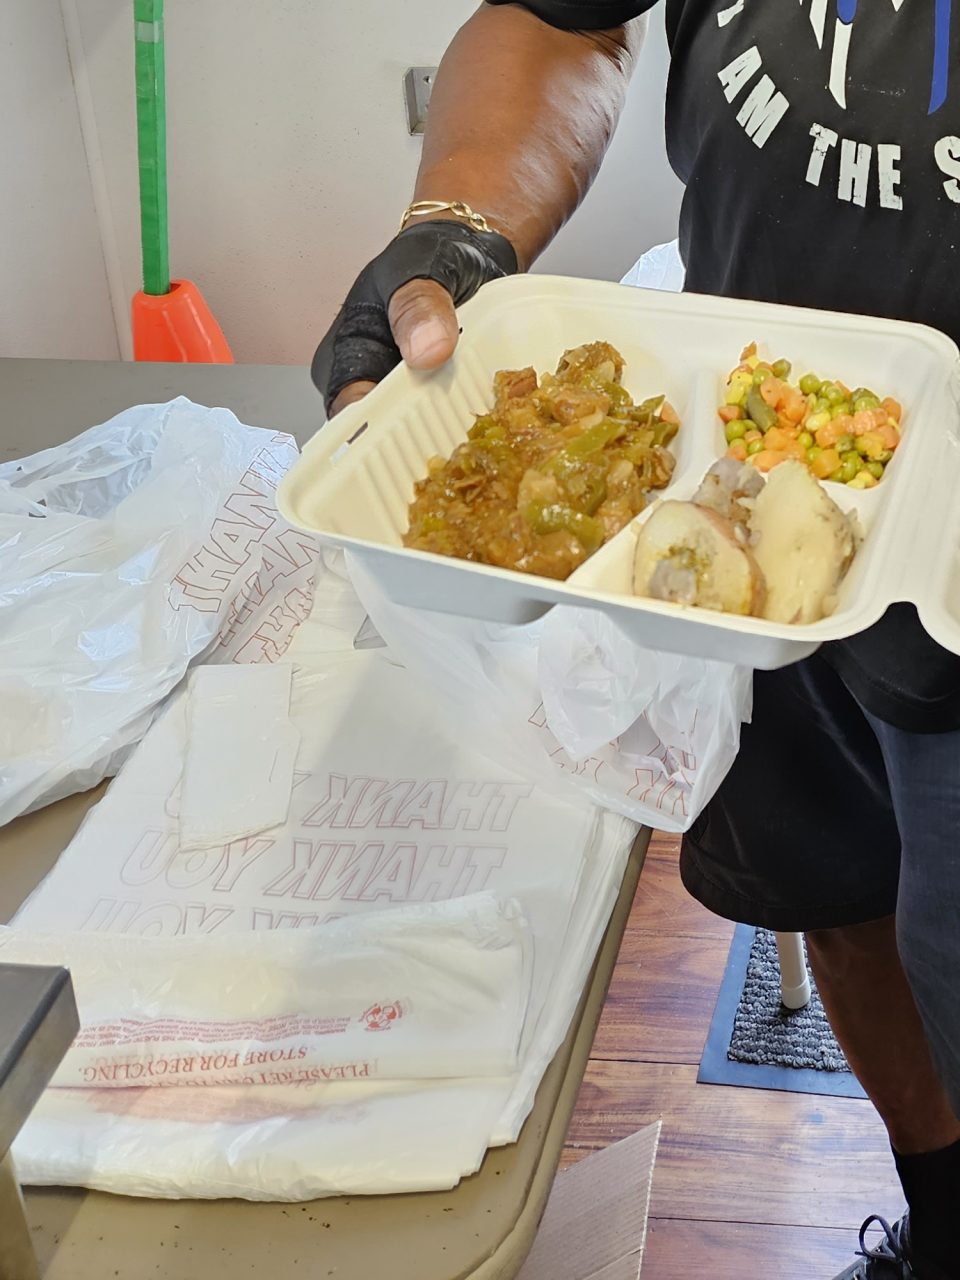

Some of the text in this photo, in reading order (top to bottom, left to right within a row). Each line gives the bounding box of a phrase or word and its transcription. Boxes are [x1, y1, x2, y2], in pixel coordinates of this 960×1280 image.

[717, 45, 790, 149] AM
[805, 122, 903, 211] THE
[78, 1046, 308, 1082] STORE FOR RECYCLING.
[298, 1063, 370, 1081] PLEASE
